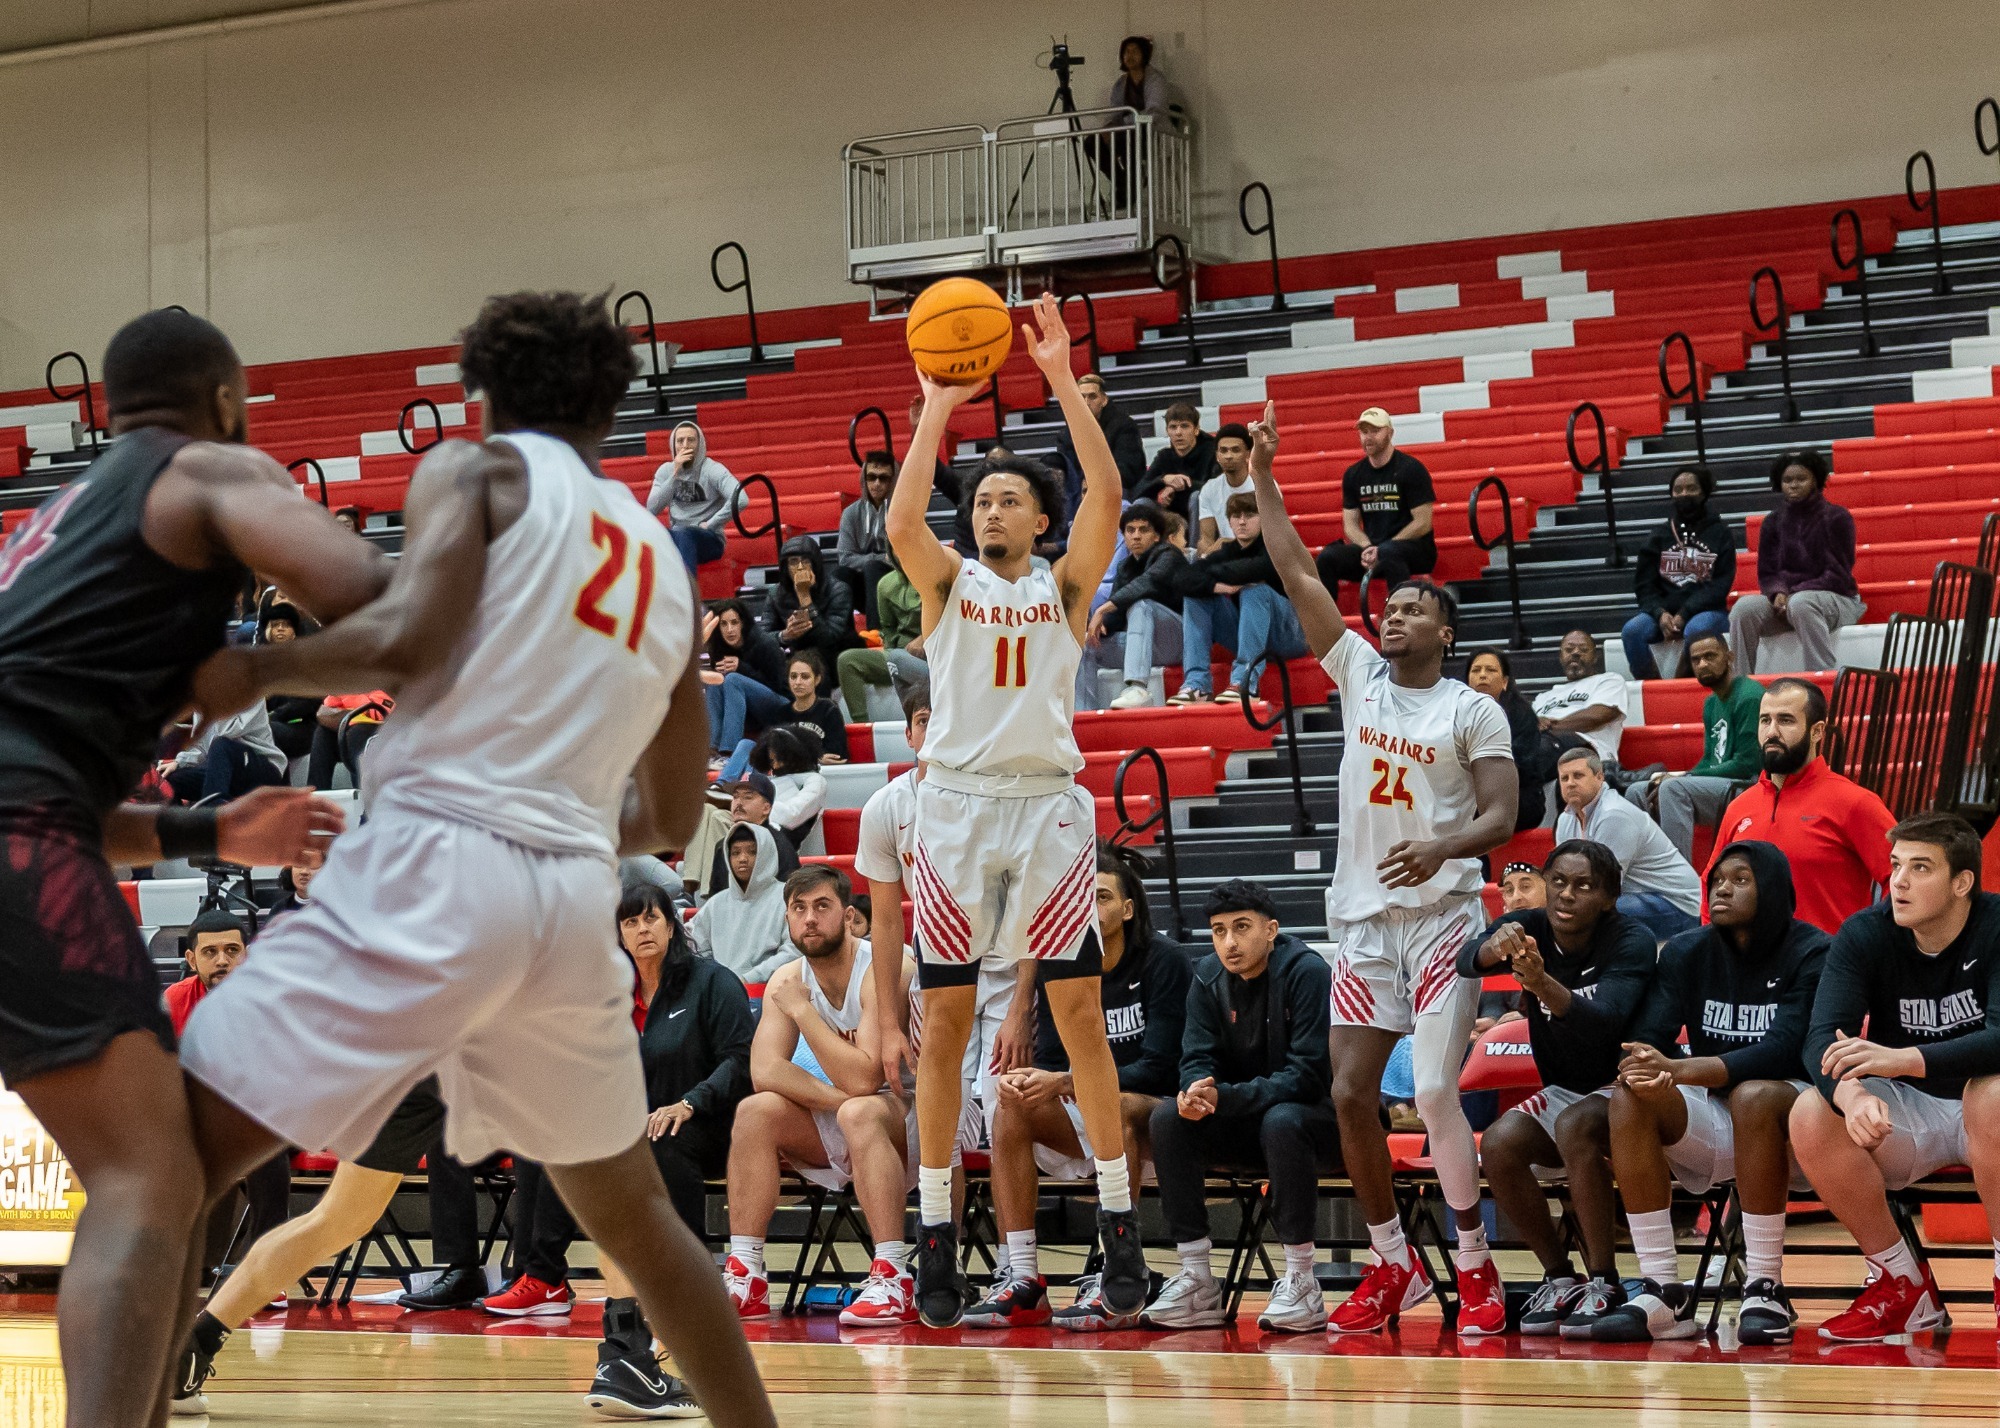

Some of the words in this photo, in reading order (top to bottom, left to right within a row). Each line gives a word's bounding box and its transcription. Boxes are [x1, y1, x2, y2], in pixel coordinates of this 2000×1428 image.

[574, 509, 656, 655] 21
[960, 599, 1061, 627] WARRIORS
[993, 635, 1028, 688] 11
[1369, 758, 1413, 811] 24
[1106, 1002, 1145, 1034] STATE
[1703, 999, 1733, 1030] STA
[1940, 988, 1983, 1024] STATE
[0, 1125, 45, 1168] GET
[0, 1160, 72, 1210] GAME
[50, 1210, 74, 1219] BRYAN
